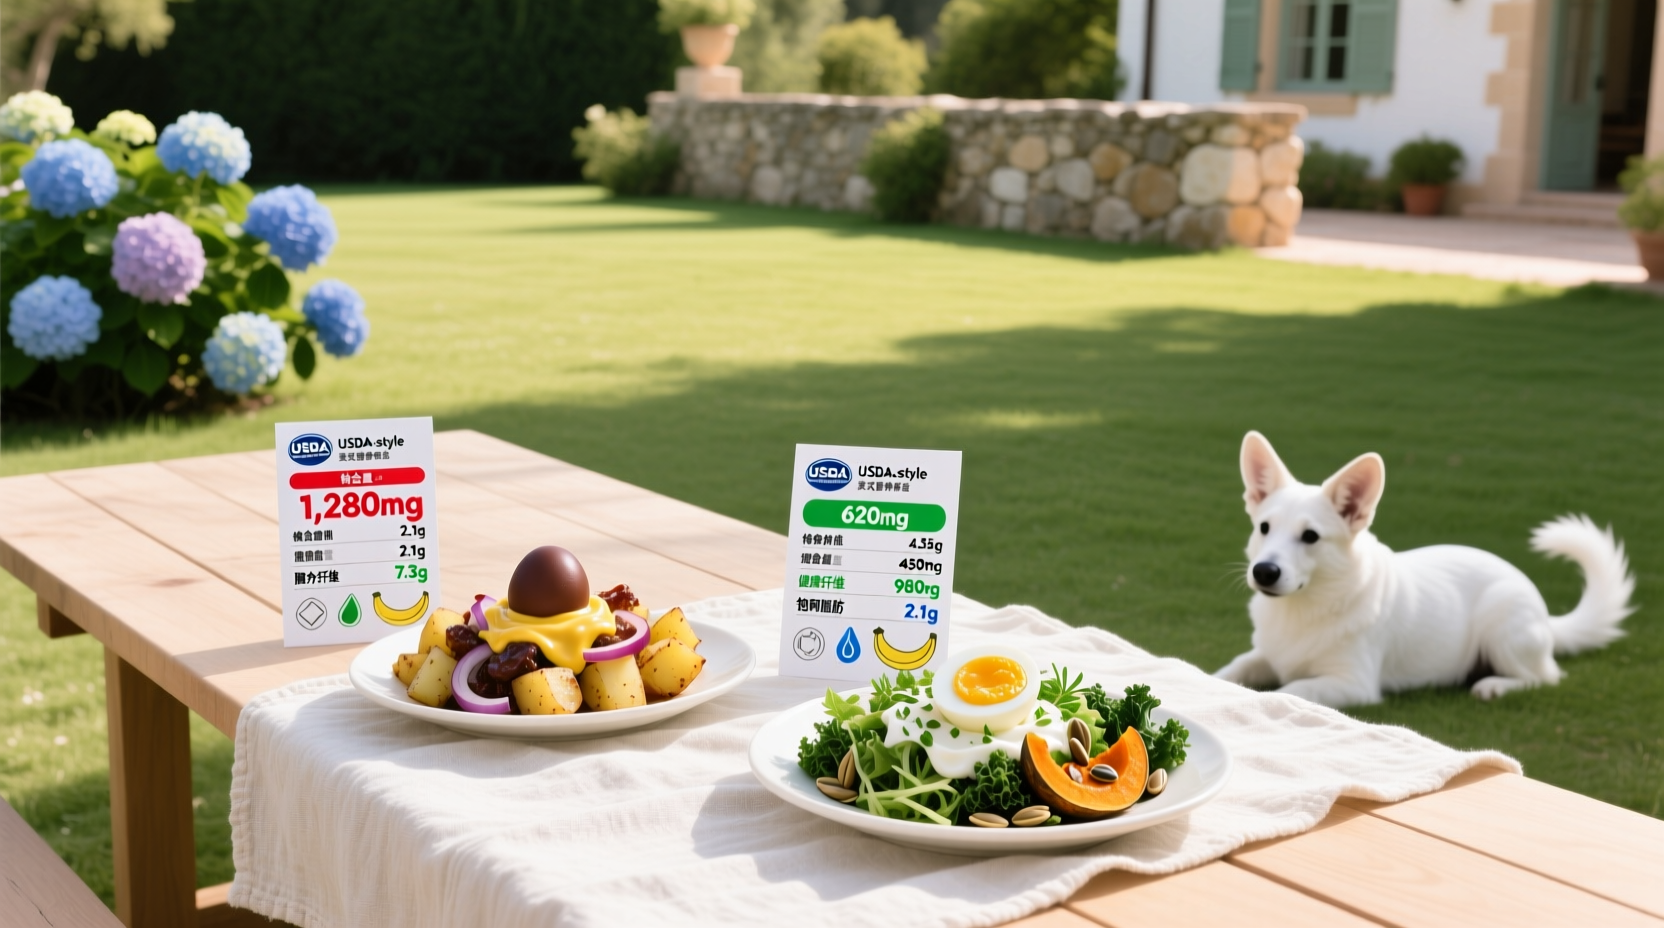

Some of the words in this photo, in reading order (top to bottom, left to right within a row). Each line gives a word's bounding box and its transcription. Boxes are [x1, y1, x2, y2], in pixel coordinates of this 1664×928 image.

[808, 465, 848, 479] USDA
[300, 491, 423, 525] 1,280mg
[841, 505, 909, 531] 620mg
[400, 525, 426, 539] 2.1g
[400, 545, 425, 560] 2.1g
[395, 564, 428, 583] 7.3g
[904, 603, 939, 625] 2.1g
